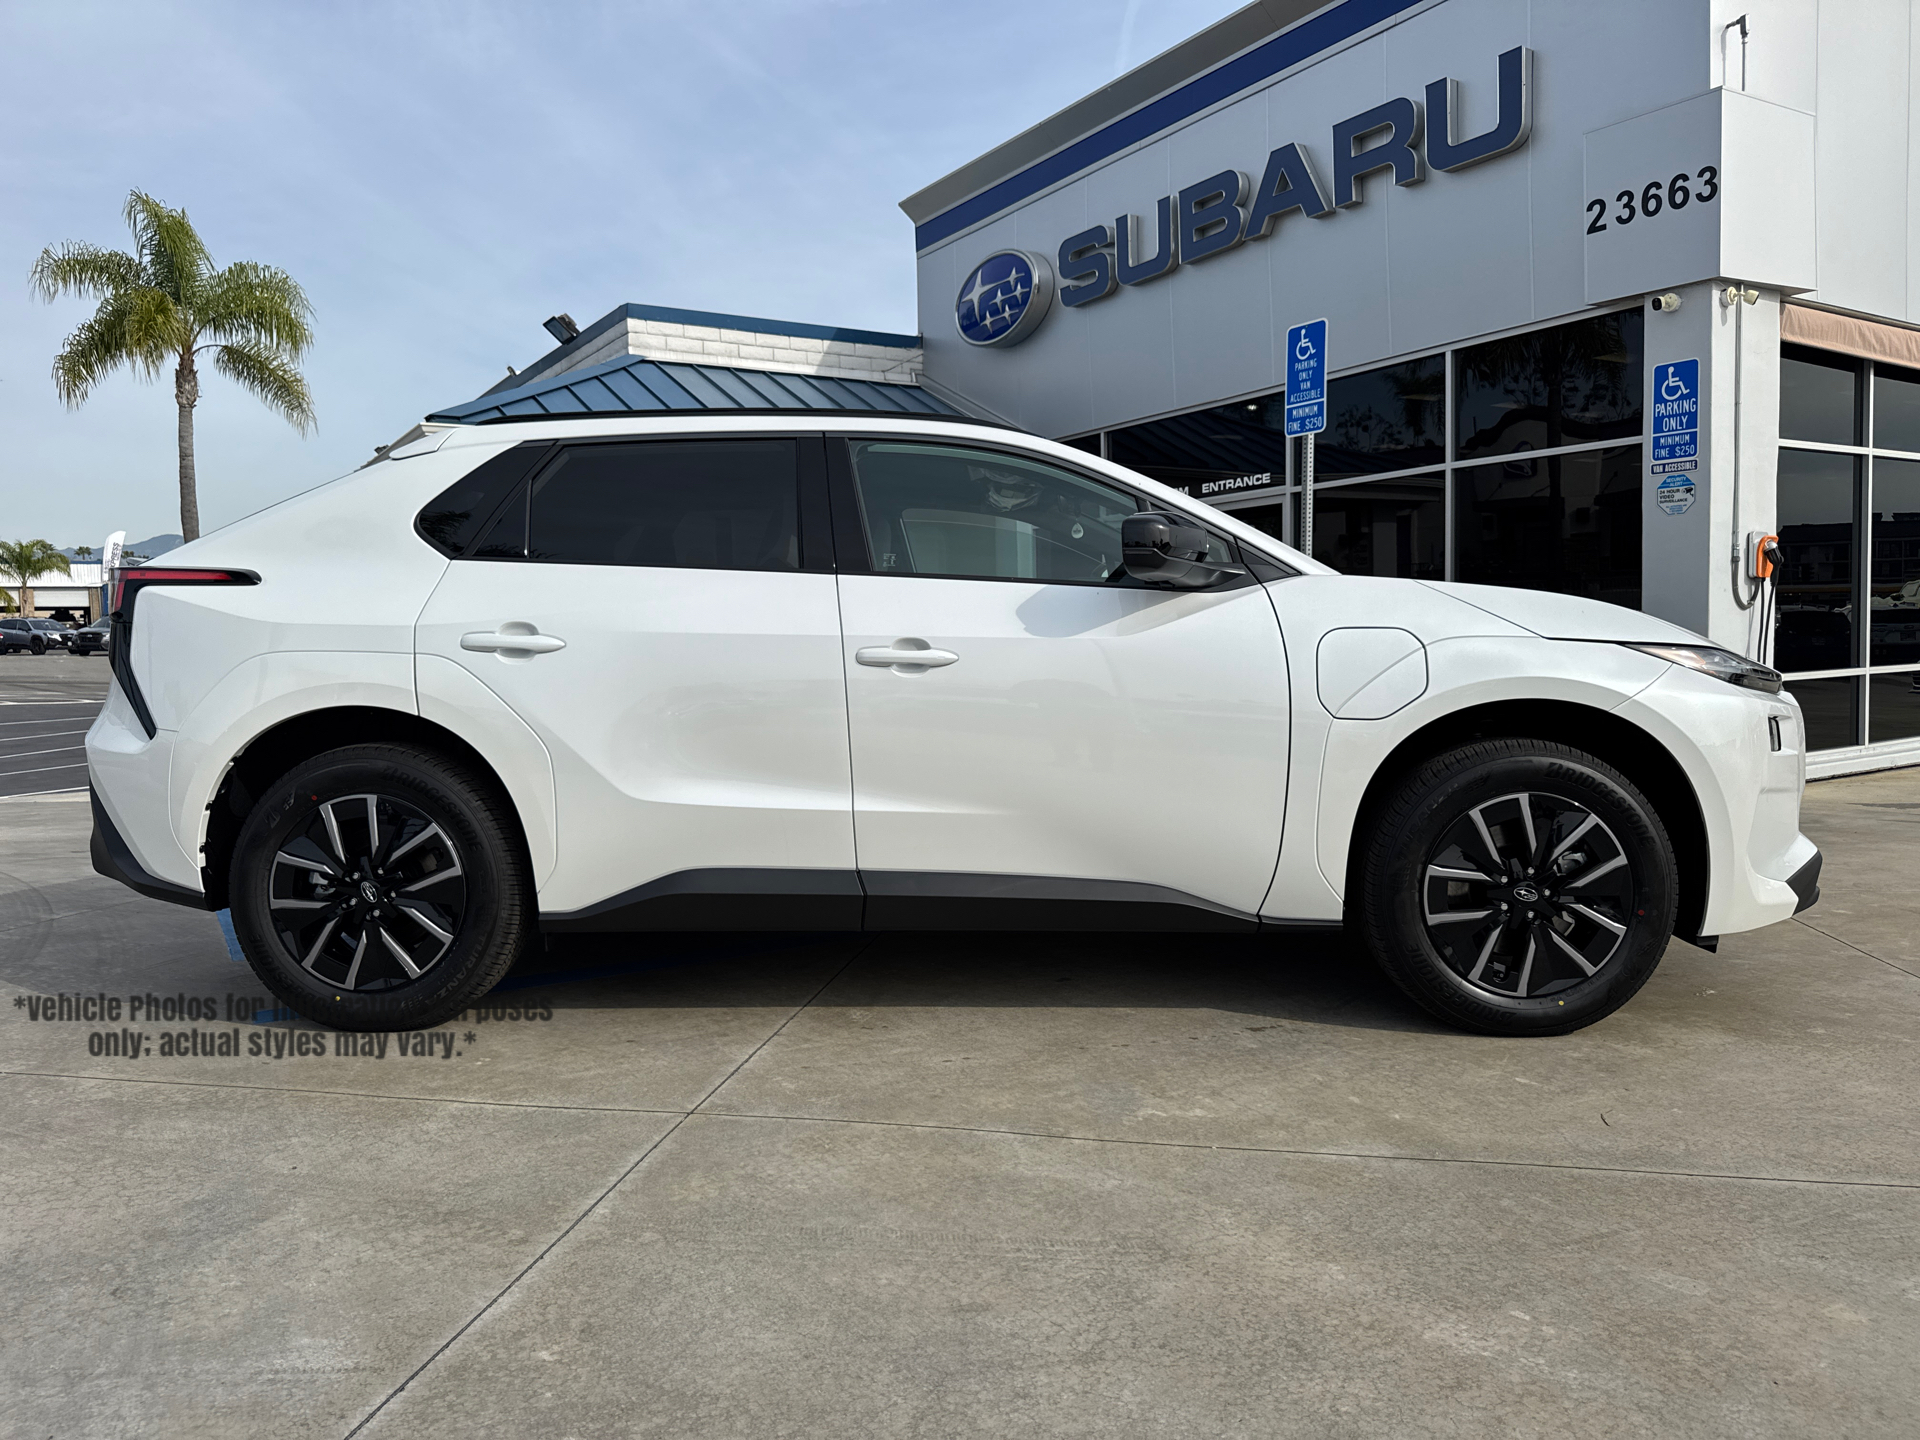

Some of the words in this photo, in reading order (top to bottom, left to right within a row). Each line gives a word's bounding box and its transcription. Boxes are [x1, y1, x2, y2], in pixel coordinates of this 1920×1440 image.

[1058, 45, 1534, 308] SUBARU
[1586, 165, 1719, 236] 23663
[1294, 358, 1318, 372] PARKING
[1298, 369, 1313, 381] ONLY
[1300, 381, 1311, 391] VAN
[1290, 388, 1321, 403] ACCESSIBLE
[1292, 404, 1318, 419] MINIMUM
[1655, 398, 1697, 418] PARKING
[1288, 420, 1301, 433] FINE
[1662, 415, 1689, 432] ONLY
[1660, 433, 1690, 447] MINIMUM
[1654, 447, 1670, 459] FINE
[1675, 444, 1695, 457] $250
[1652, 464, 1664, 474] VAN
[1665, 461, 1696, 473] ACCESSIBLE
[1202, 472, 1271, 494] ENTRANCE
[1543, 762, 1657, 848] BRIDGESTONE
